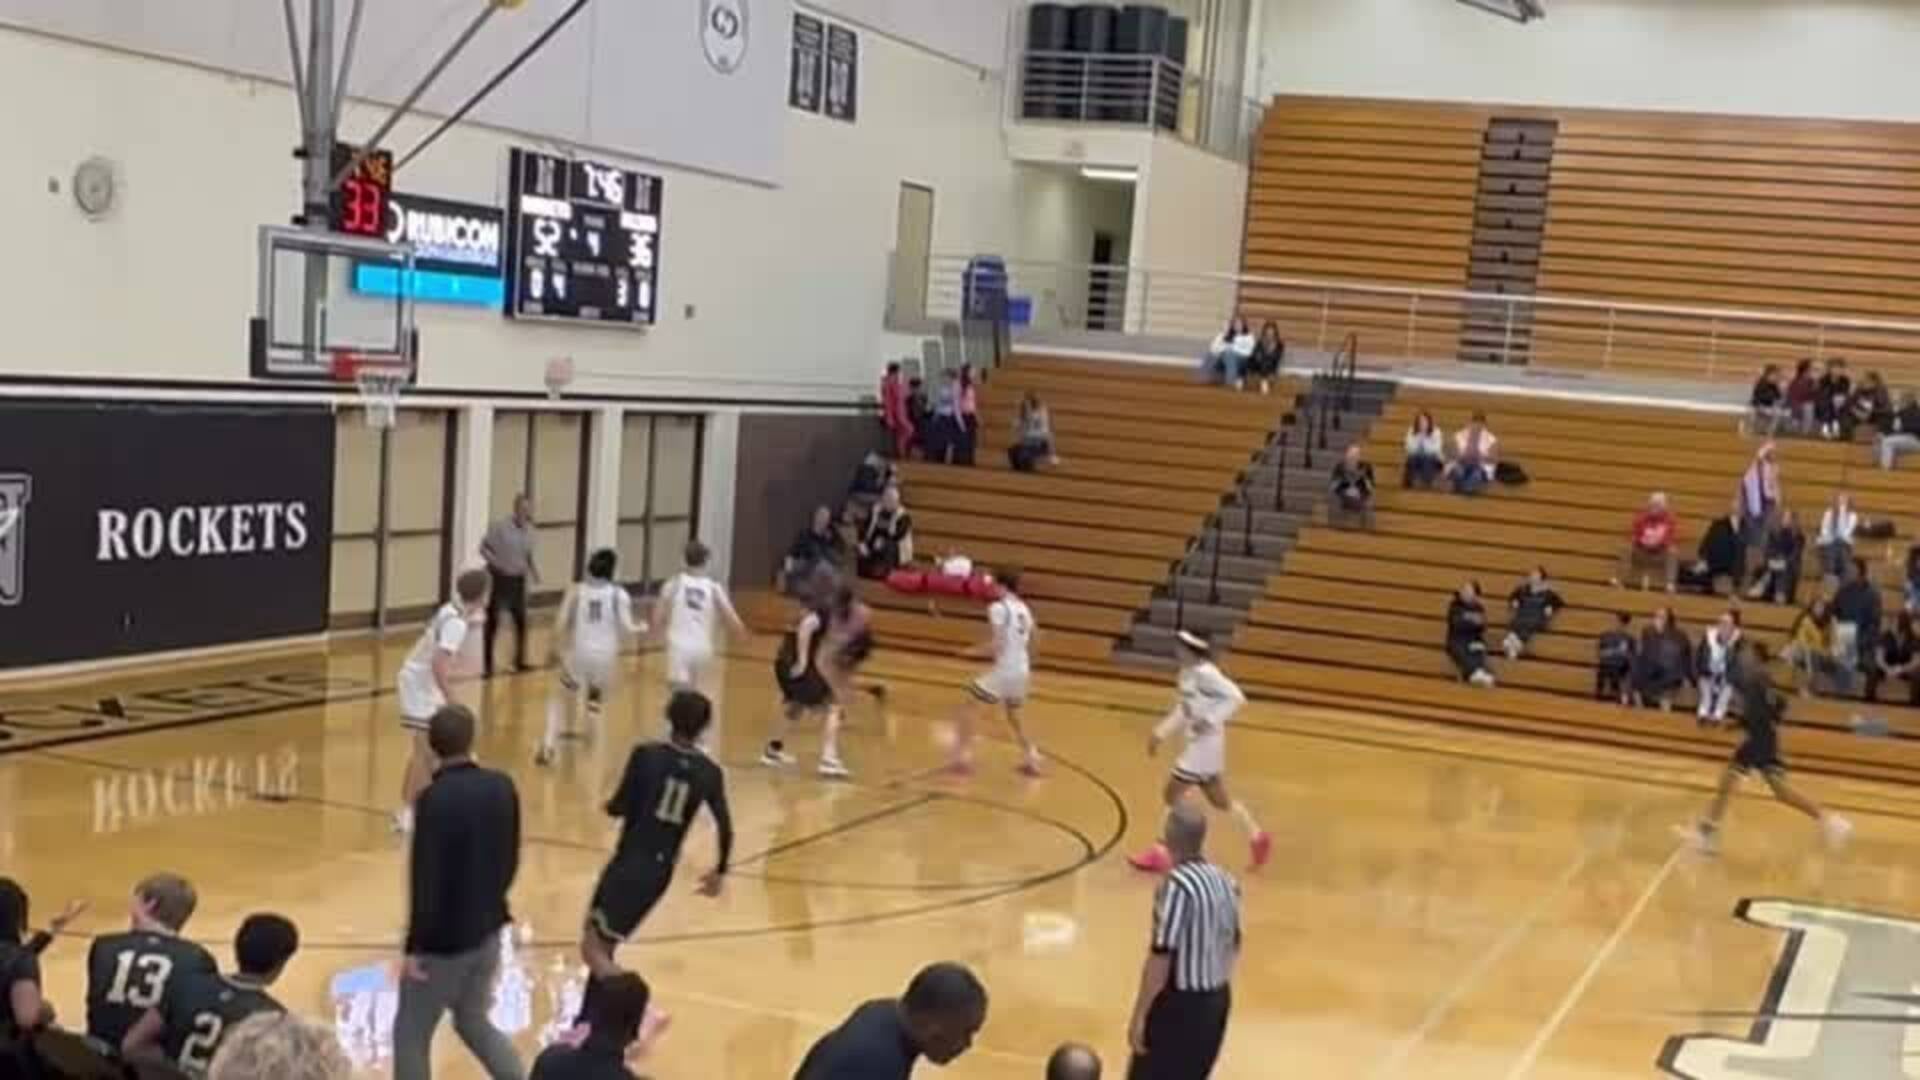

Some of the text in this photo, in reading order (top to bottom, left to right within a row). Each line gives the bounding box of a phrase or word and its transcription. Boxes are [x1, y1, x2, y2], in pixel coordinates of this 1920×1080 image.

[343, 181, 380, 233] 33
[97, 502, 309, 561] ROCKETS
[656, 776, 690, 824] 11
[105, 950, 173, 1007] 13
